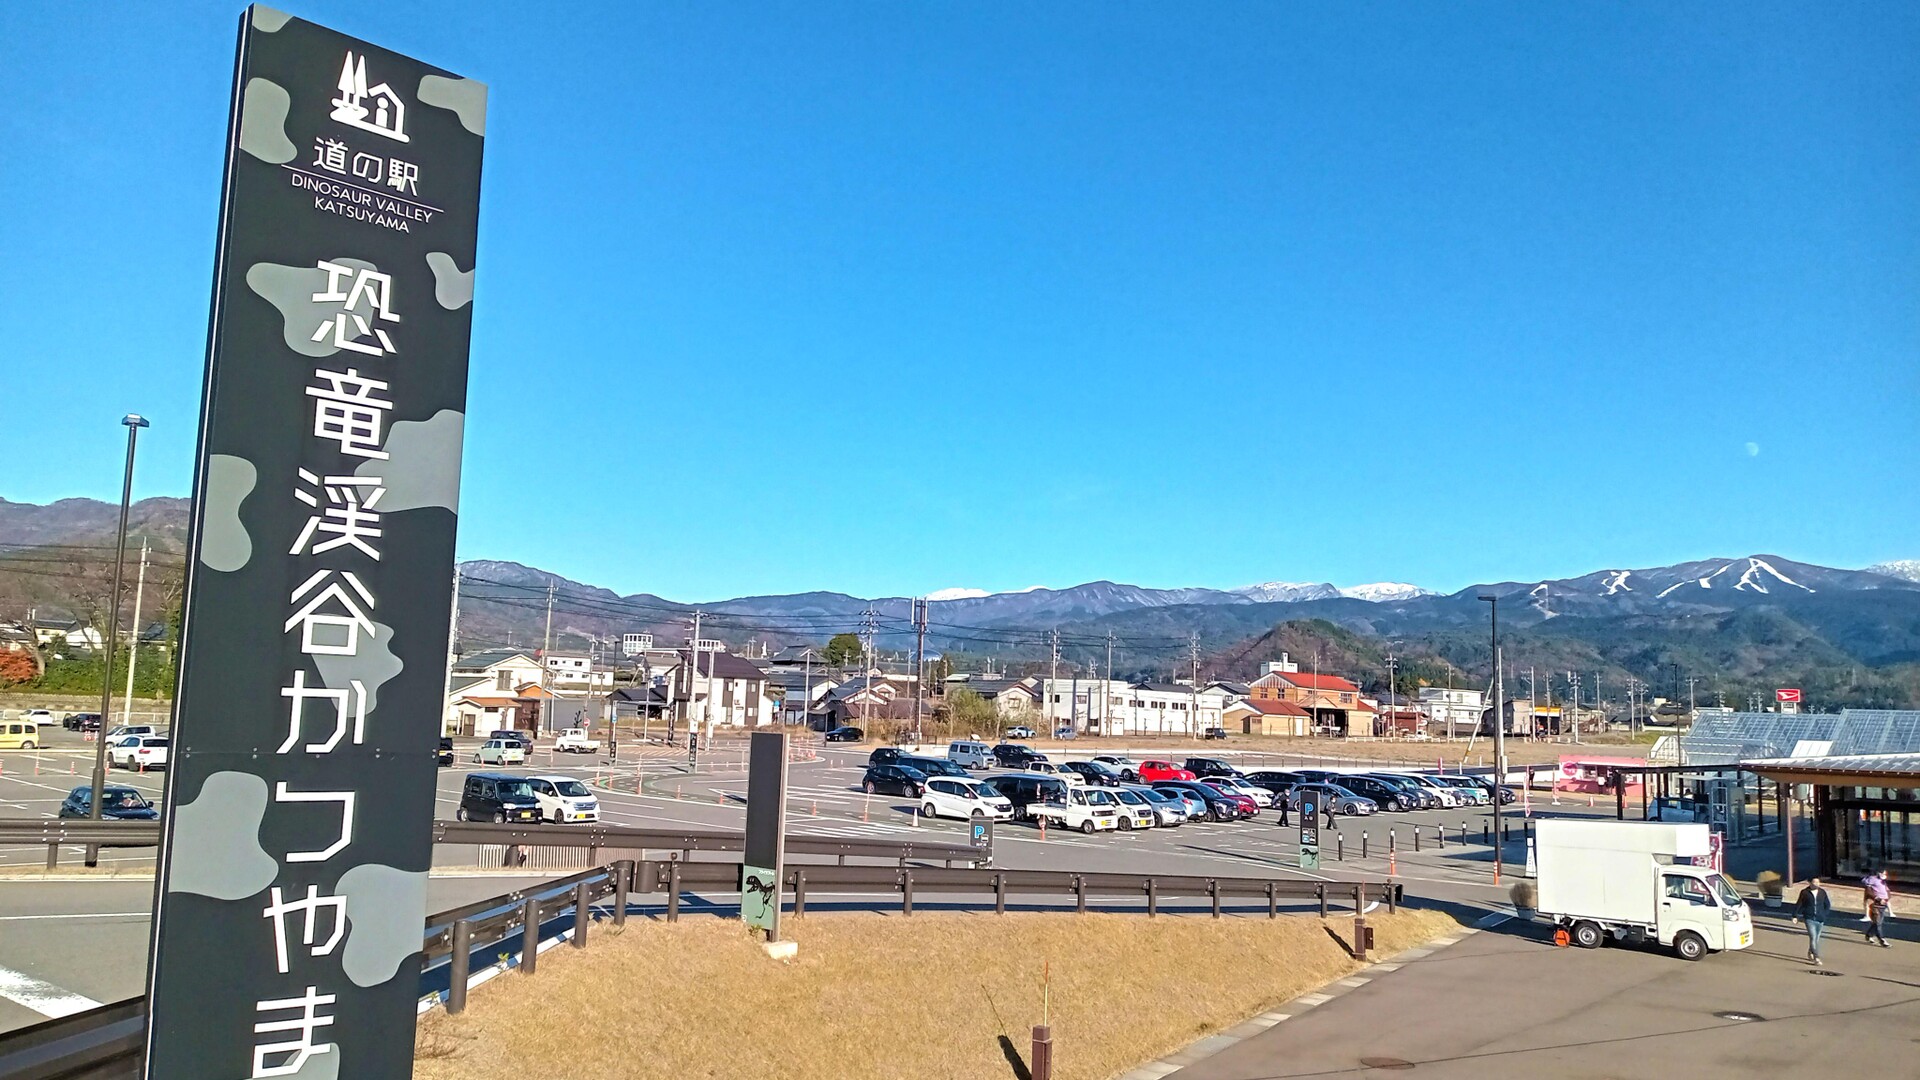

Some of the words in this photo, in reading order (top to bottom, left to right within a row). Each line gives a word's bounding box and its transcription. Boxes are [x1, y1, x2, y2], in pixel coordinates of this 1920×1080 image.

[313, 137, 418, 196] 道の駅
[291, 174, 372, 206] DINOSAUR
[375, 197, 432, 223] VALLEY
[314, 196, 409, 233] KATSUYAMA
[252, 260, 400, 1079] 恐竜渓谷かつやま
